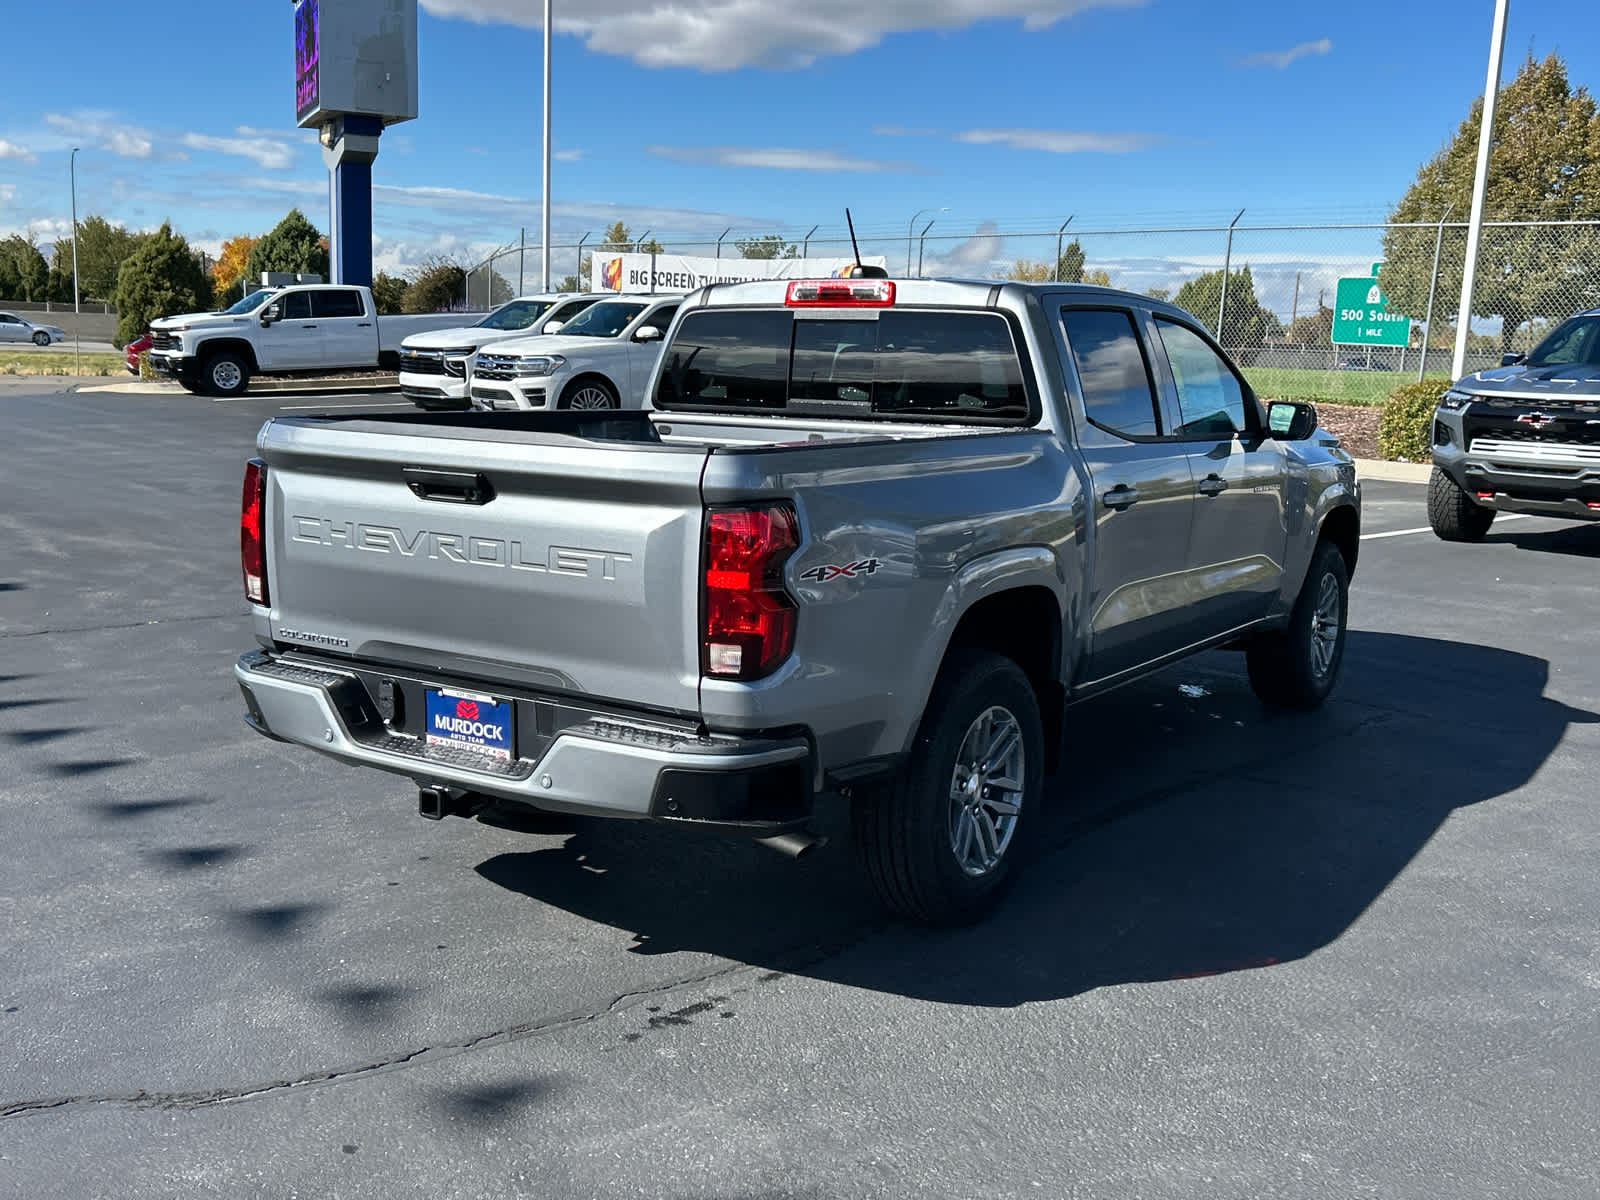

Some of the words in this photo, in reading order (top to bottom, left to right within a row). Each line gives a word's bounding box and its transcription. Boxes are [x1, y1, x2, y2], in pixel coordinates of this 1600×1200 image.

[630, 270, 648, 286] BIG
[651, 271, 695, 289] SCREEN
[1341, 309, 1363, 321] 500
[1366, 328, 1382, 337] MILE
[292, 515, 633, 581] CHEVROLET
[279, 628, 349, 648] COLORADO
[434, 714, 503, 741] MURDOCK
[468, 736, 485, 744] TEAM
